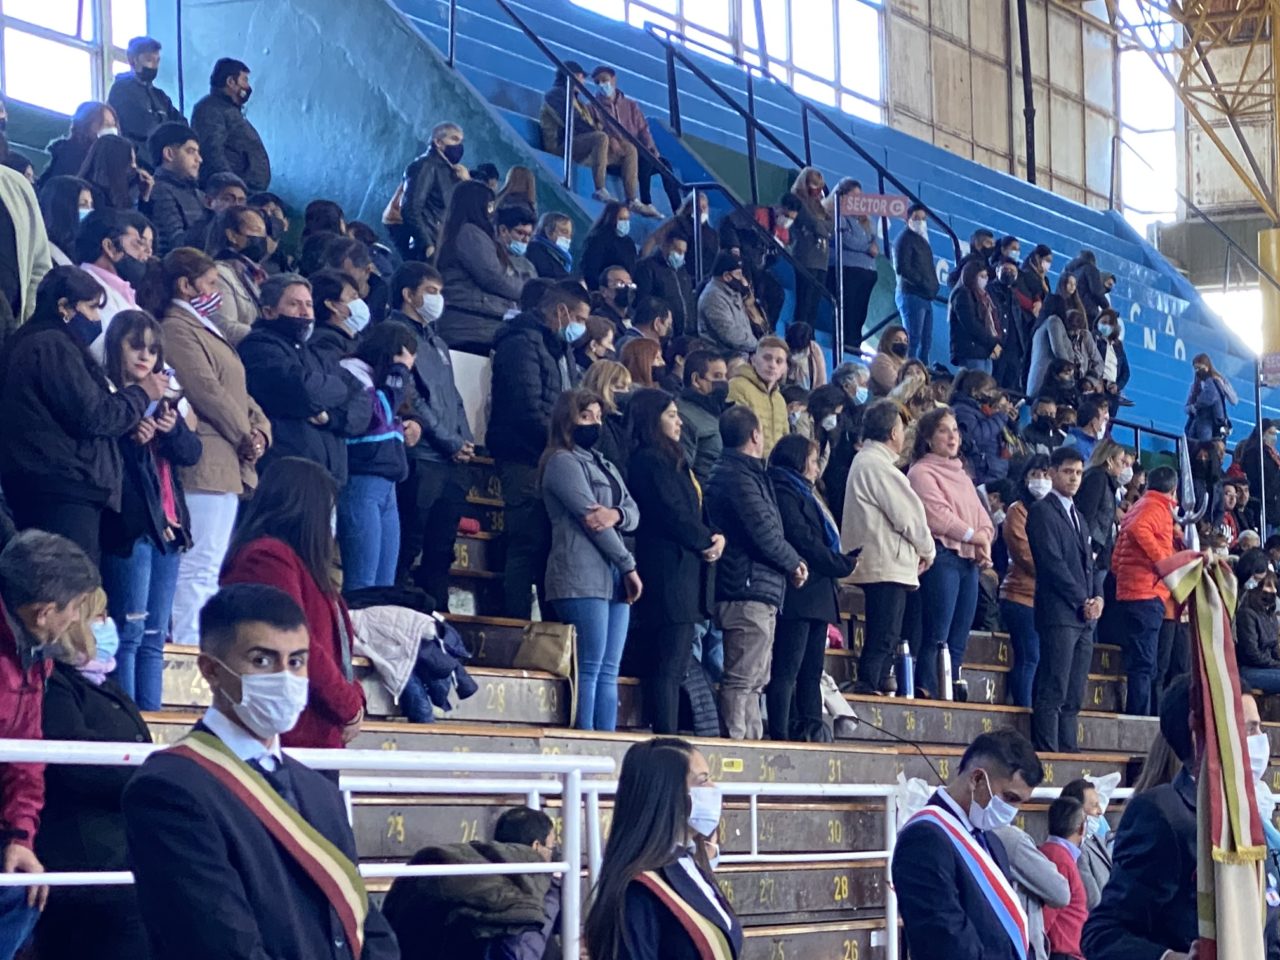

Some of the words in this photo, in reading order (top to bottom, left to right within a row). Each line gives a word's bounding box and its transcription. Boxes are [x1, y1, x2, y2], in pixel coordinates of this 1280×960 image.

[846, 196, 887, 213] SECTOR
[828, 758, 842, 783] 31
[827, 818, 842, 844] 30
[833, 875, 849, 901] 28
